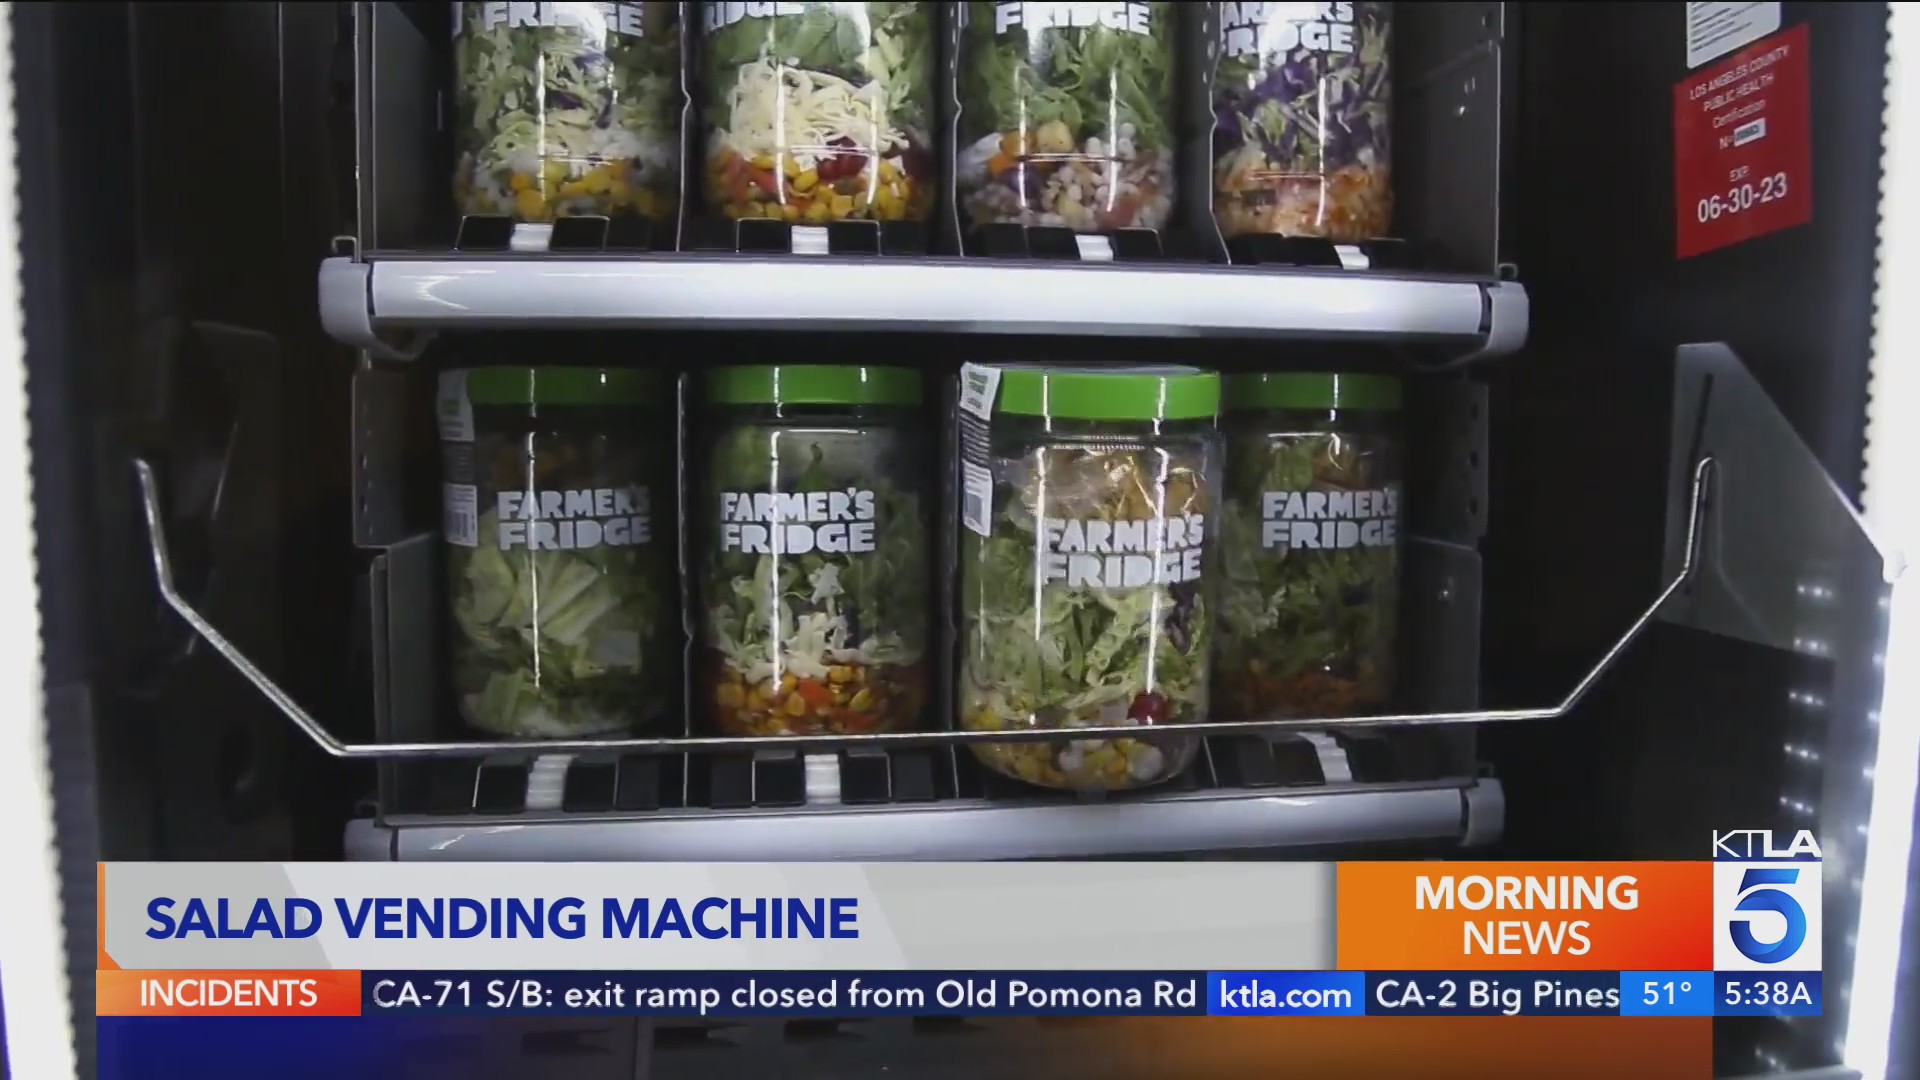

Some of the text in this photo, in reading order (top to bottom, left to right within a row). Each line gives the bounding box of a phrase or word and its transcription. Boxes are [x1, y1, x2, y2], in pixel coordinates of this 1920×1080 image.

[1690, 83, 1708, 100] LOS
[1698, 172, 1787, 223] 06-30-23
[720, 487, 875, 521] FARMER'S
[499, 516, 652, 551] FRIDGE
[721, 522, 876, 555] FRIDGE
[1262, 519, 1396, 549] FRIDGE
[1041, 549, 1202, 587] FRIDGE
